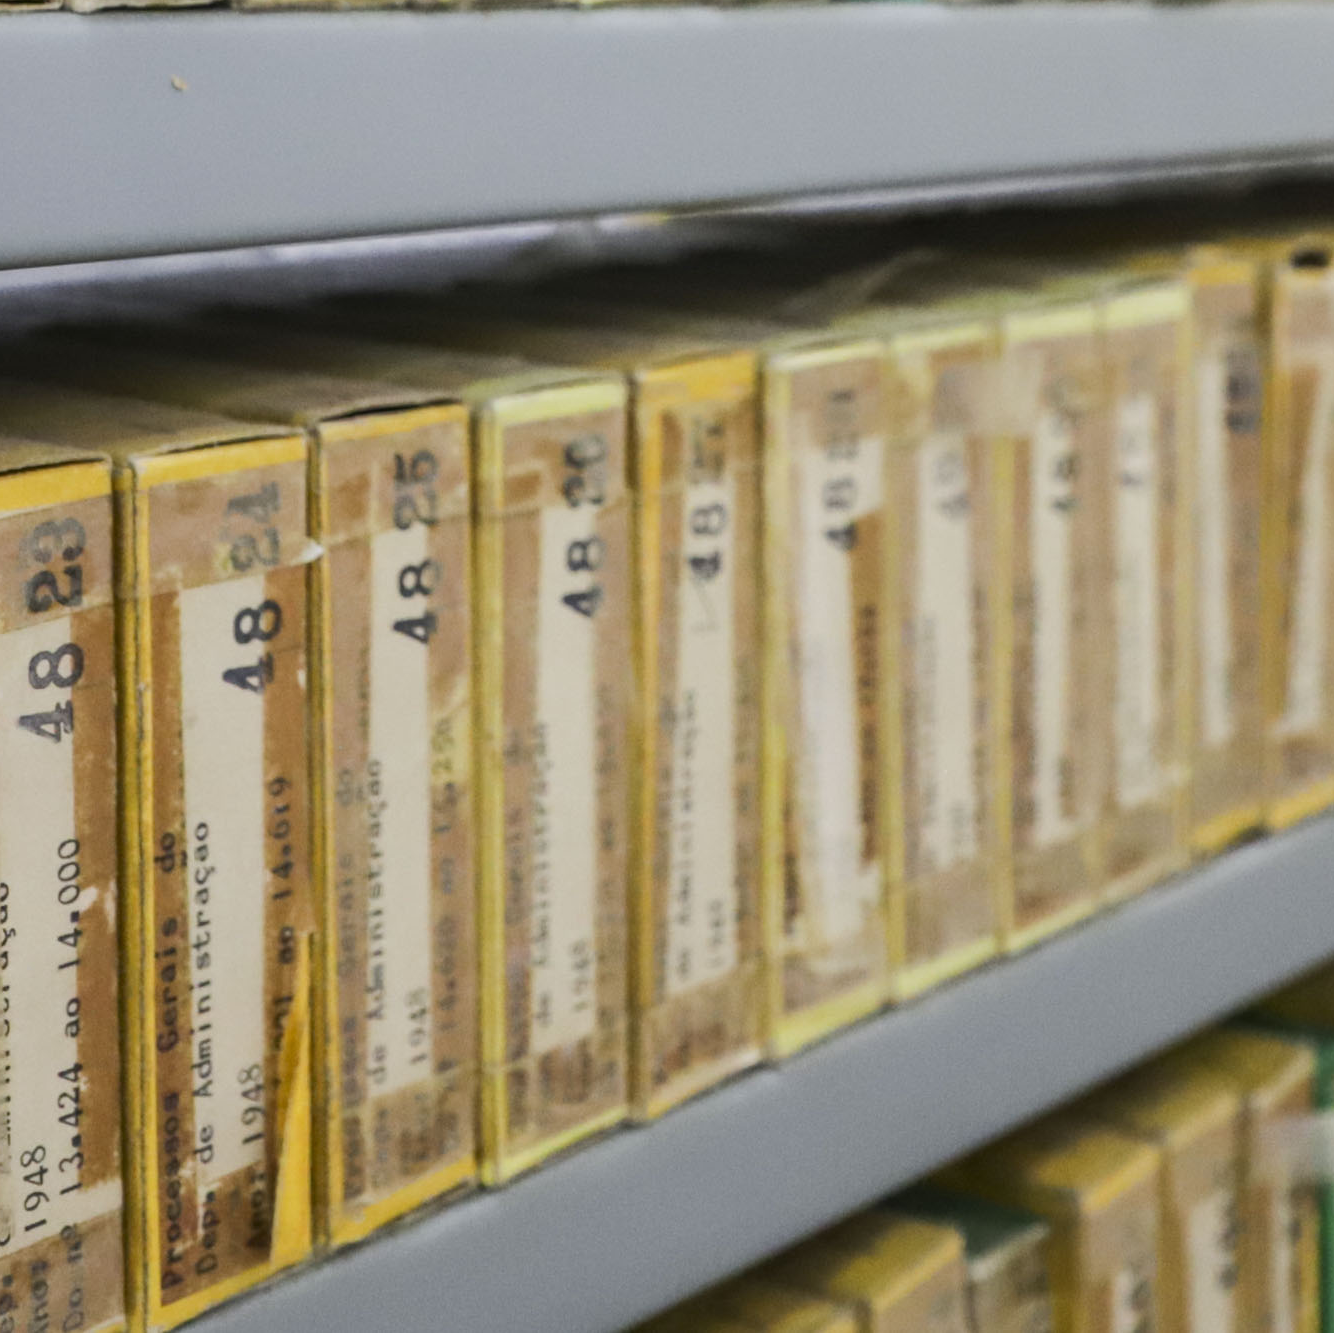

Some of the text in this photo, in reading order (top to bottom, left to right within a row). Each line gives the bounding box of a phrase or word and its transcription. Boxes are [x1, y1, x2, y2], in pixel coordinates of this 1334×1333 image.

[391, 556, 442, 647] 48
[559, 536, 607, 619] 48
[15, 515, 88, 746] 48 23
[221, 596, 284, 694] 48
[153, 829, 178, 876] do
[55, 837, 83, 972] 14.000
[63, 994, 82, 1040] ao
[154, 914, 181, 1055] Gerais
[182, 819, 219, 1278] Dep. de Administração
[55, 1061, 86, 1197] 13.424
[235, 1062, 265, 1148] 1948
[17, 1142, 51, 1234] 1948
